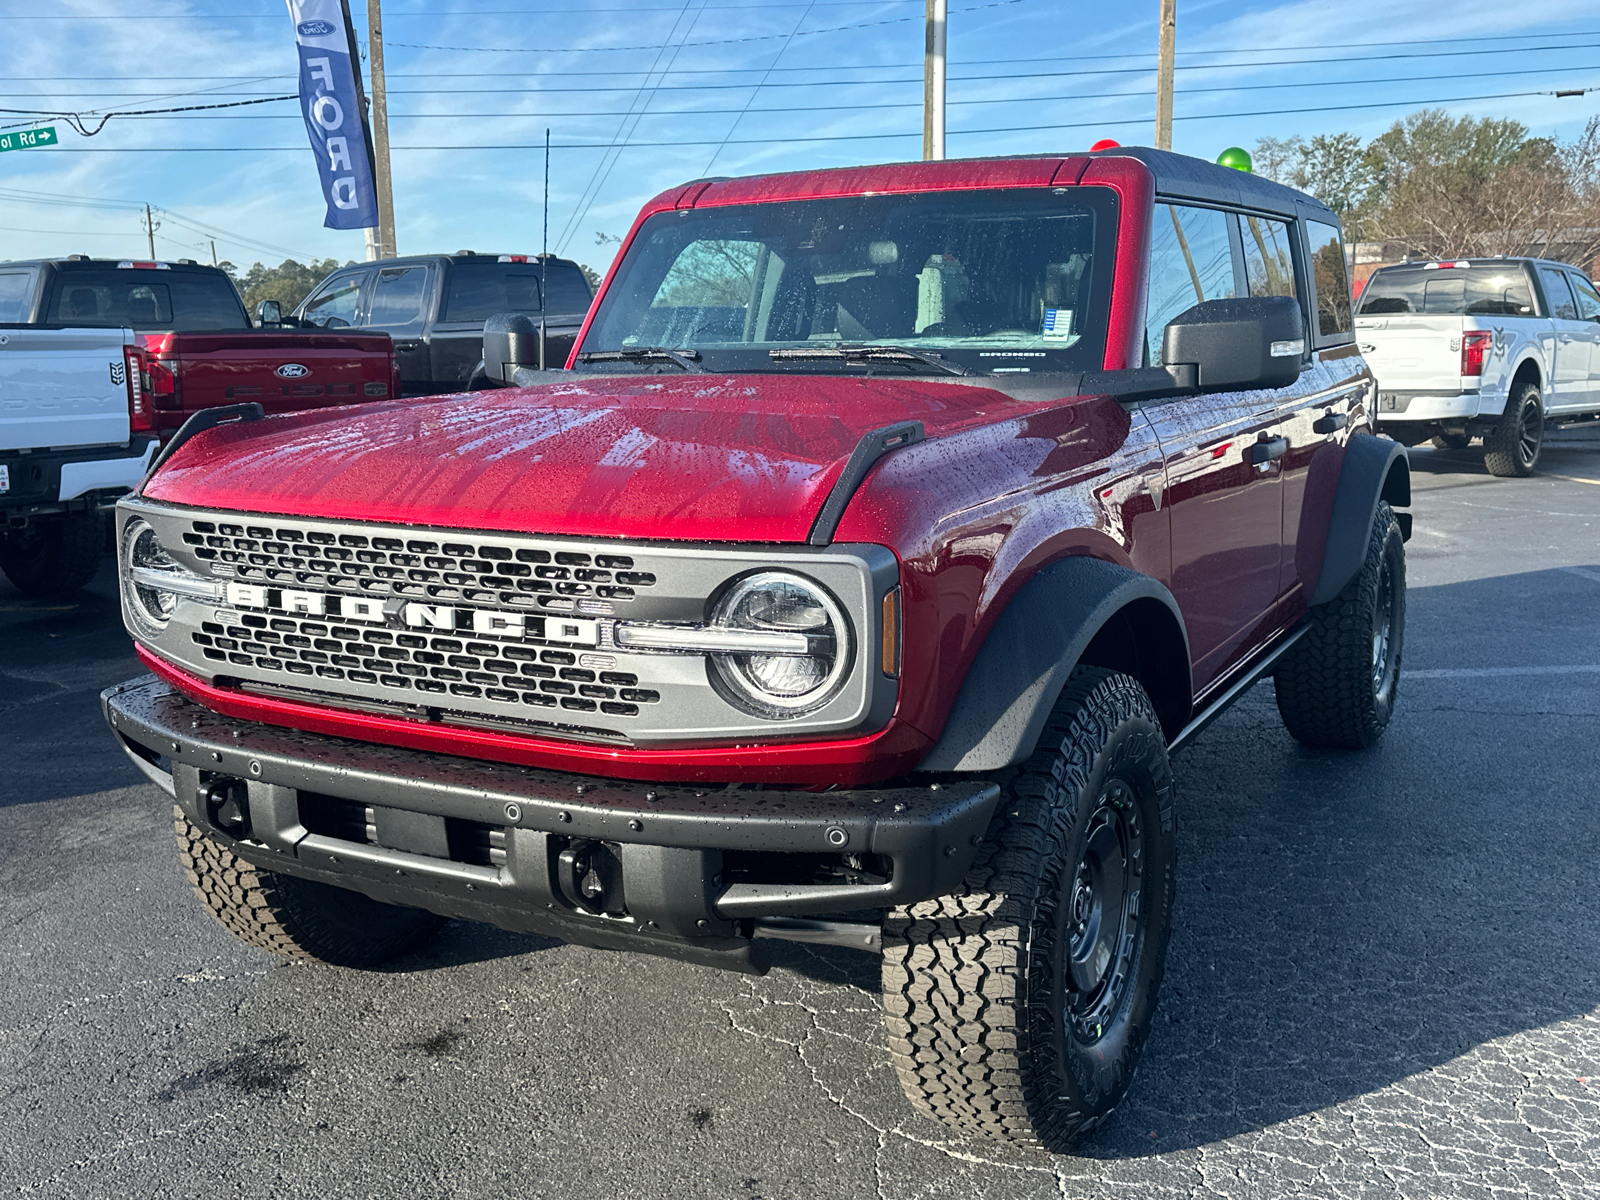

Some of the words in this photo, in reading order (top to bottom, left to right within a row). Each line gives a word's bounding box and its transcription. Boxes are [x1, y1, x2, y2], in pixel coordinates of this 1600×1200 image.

[19, 131, 36, 146] Rd
[3, 395, 112, 410] DUTY
[226, 582, 600, 648] BRONCO
